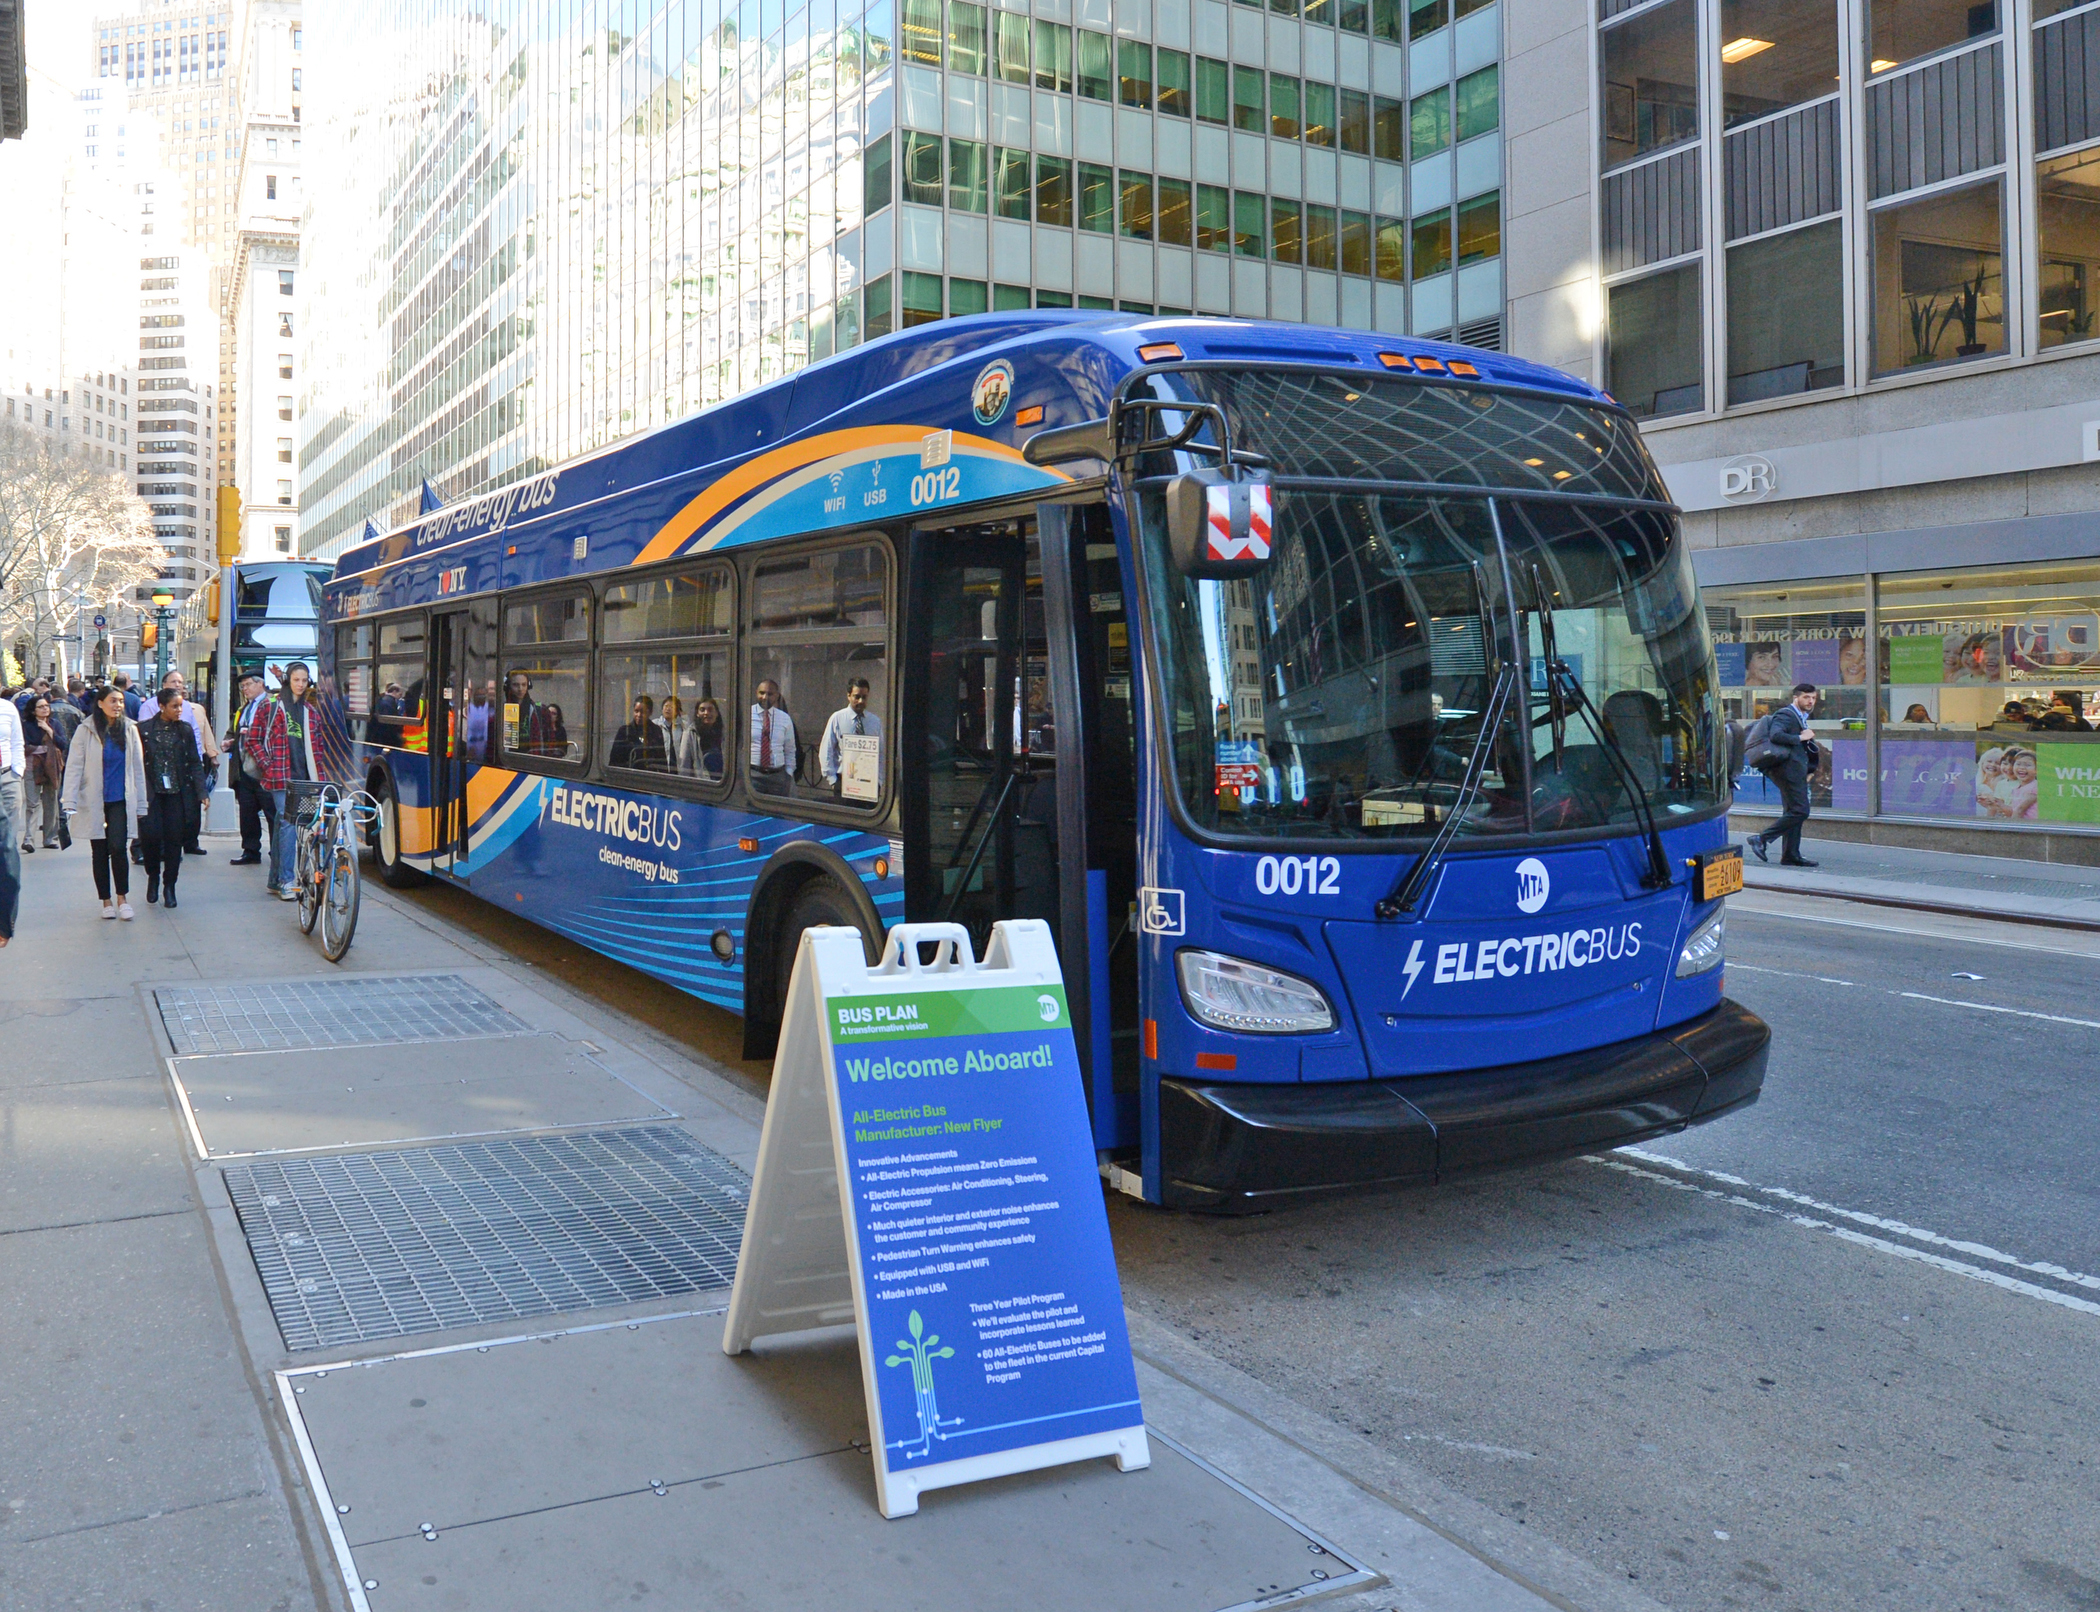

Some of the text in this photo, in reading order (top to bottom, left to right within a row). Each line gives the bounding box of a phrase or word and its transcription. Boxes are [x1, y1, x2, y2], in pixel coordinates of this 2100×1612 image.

[911, 467, 960, 506] 0012
[1720, 463, 1776, 496] DR
[824, 496, 846, 513] WIFI
[864, 489, 886, 506] USB
[449, 566, 468, 593] NY
[844, 738, 877, 750] Fare $2.75
[552, 786, 682, 851] ELECTRICBUS
[599, 846, 678, 884] clean-energy bus
[1256, 856, 1340, 895] 0012
[1515, 870, 1546, 903] MTA
[1433, 922, 1642, 984] ELECTRICBUS
[837, 1004, 918, 1023] BUS PLAN
[840, 1022, 928, 1035] A transformative vision
[845, 1044, 1053, 1082] Welcome Aboard!
[852, 1104, 946, 1124] All-Electric Bus
[854, 1118, 1002, 1142] Manufacturer: New Flyer
[858, 1149, 958, 1167] Innovative Advancements
[866, 1156, 1037, 1182] All-Electric Propulsion means Zero Emissions
[868, 1173, 1048, 1200] Electric Accessories: Air Conditioning, Steering,
[870, 1198, 932, 1212] Air Compressor
[872, 1201, 1059, 1231] Much quieter interior and exterior noise enhances
[874, 1216, 1030, 1243] the customer and community experience
[876, 1234, 1035, 1262] Pedestrian Turn Warning enhances safety
[879, 1257, 989, 1281] Equipped with USB and WiFi
[882, 1282, 947, 1300] Made in the USA
[969, 1292, 1064, 1312] Three Year Pilot Program
[977, 1304, 1078, 1327] We'll evaluate the pilot and
[979, 1315, 1085, 1340] incorporate lessons learned
[982, 1331, 1106, 1359] 60 All-Electric Buses to be added
[984, 1344, 1104, 1371] to the fleet in the current Capital
[985, 1371, 1021, 1384] Program
